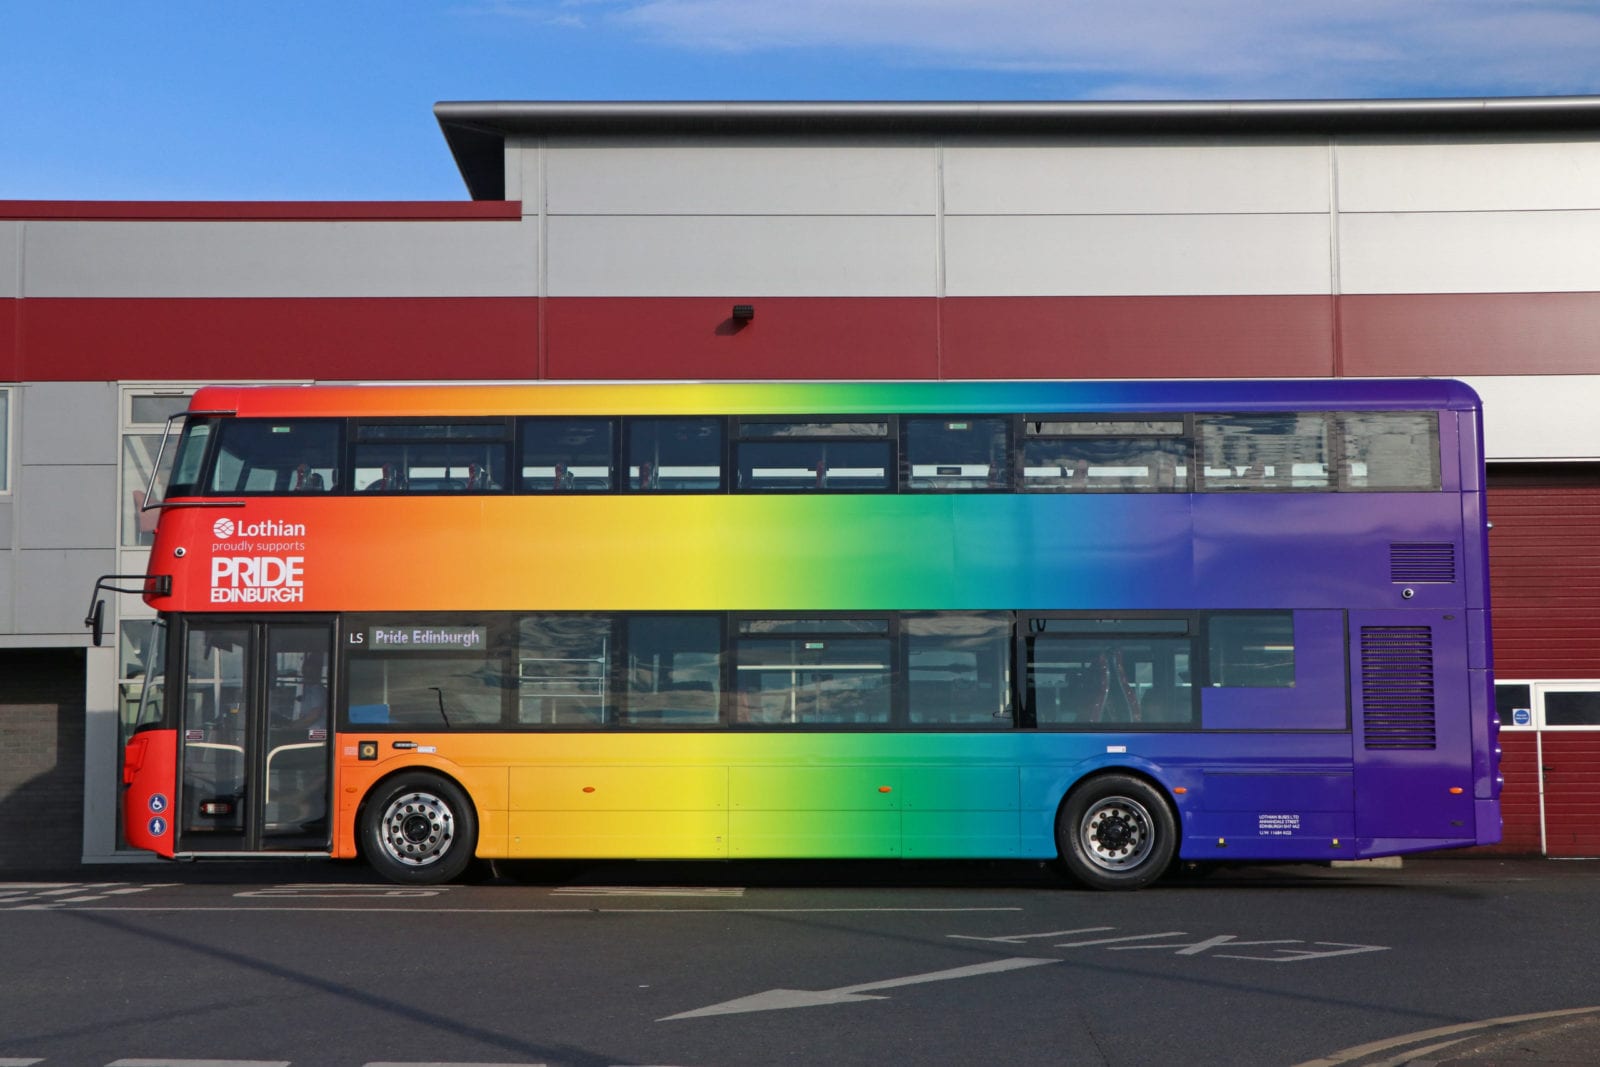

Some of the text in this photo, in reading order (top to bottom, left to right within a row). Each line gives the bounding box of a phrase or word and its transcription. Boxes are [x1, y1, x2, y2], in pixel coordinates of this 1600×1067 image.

[238, 520, 305, 537] Lothian
[212, 541, 305, 552] proudly supports
[211, 556, 304, 587] PRIDE
[210, 587, 304, 603] EDINBURGH
[349, 632, 364, 644] LS
[375, 630, 480, 647] Pride Edinburgh
